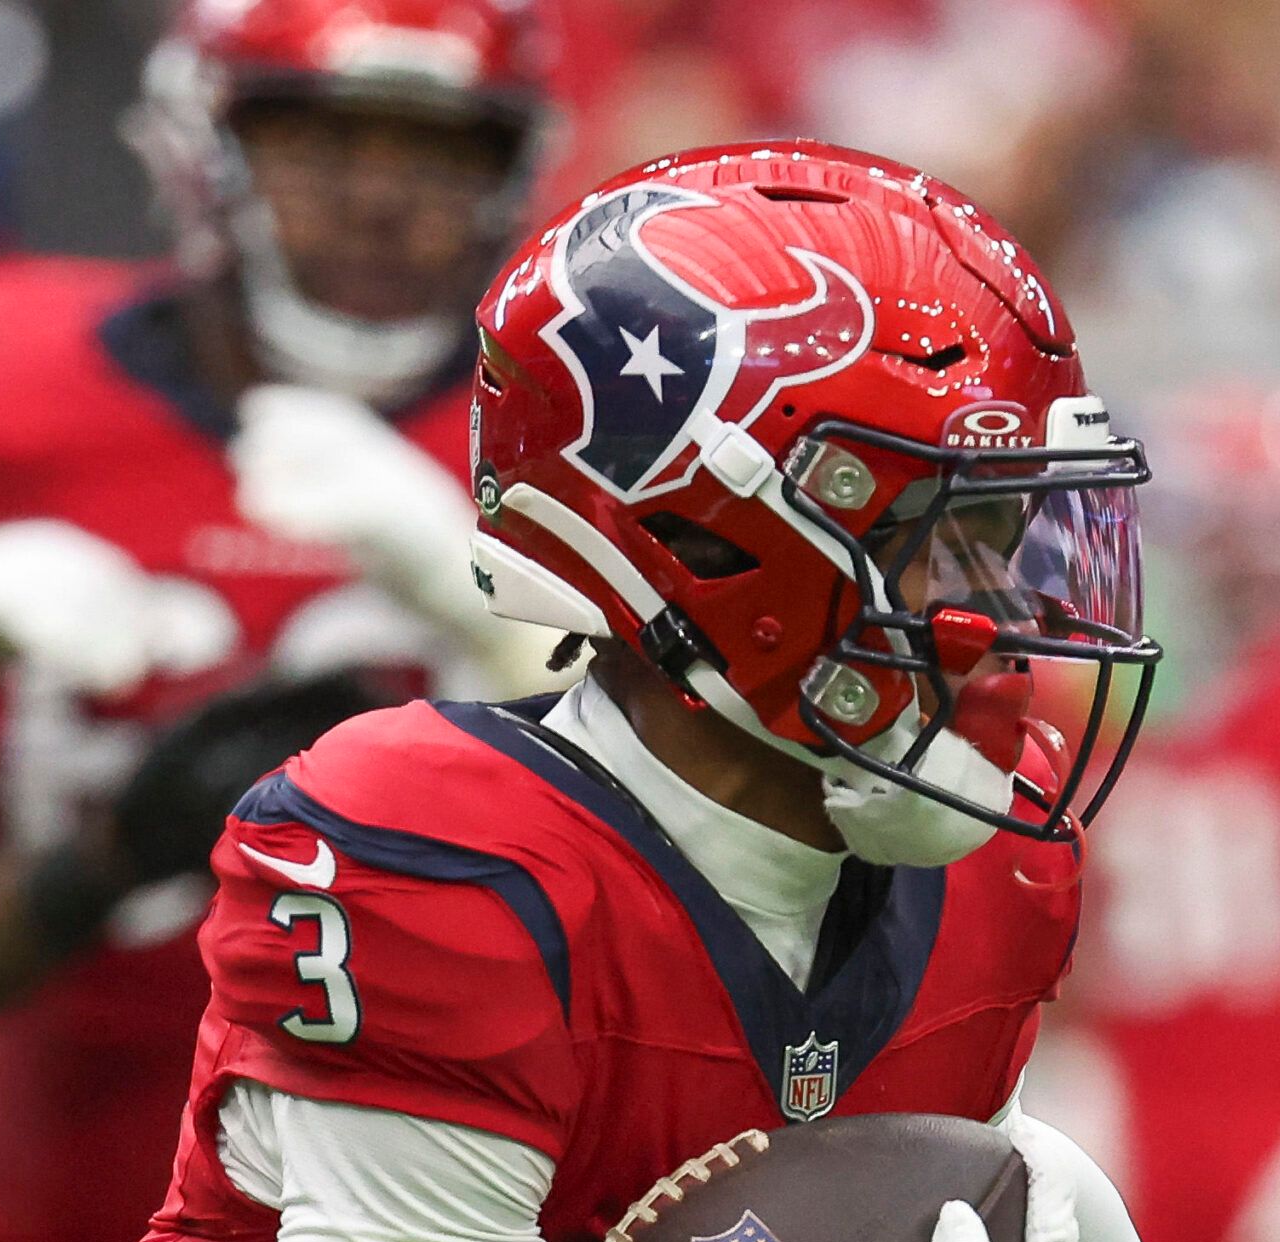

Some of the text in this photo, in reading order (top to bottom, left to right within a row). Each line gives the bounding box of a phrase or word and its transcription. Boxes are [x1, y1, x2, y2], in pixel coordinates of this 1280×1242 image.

[946, 433, 1033, 448] OAKLEY
[267, 889, 361, 1044] 3
[790, 1076, 828, 1111] NFL
